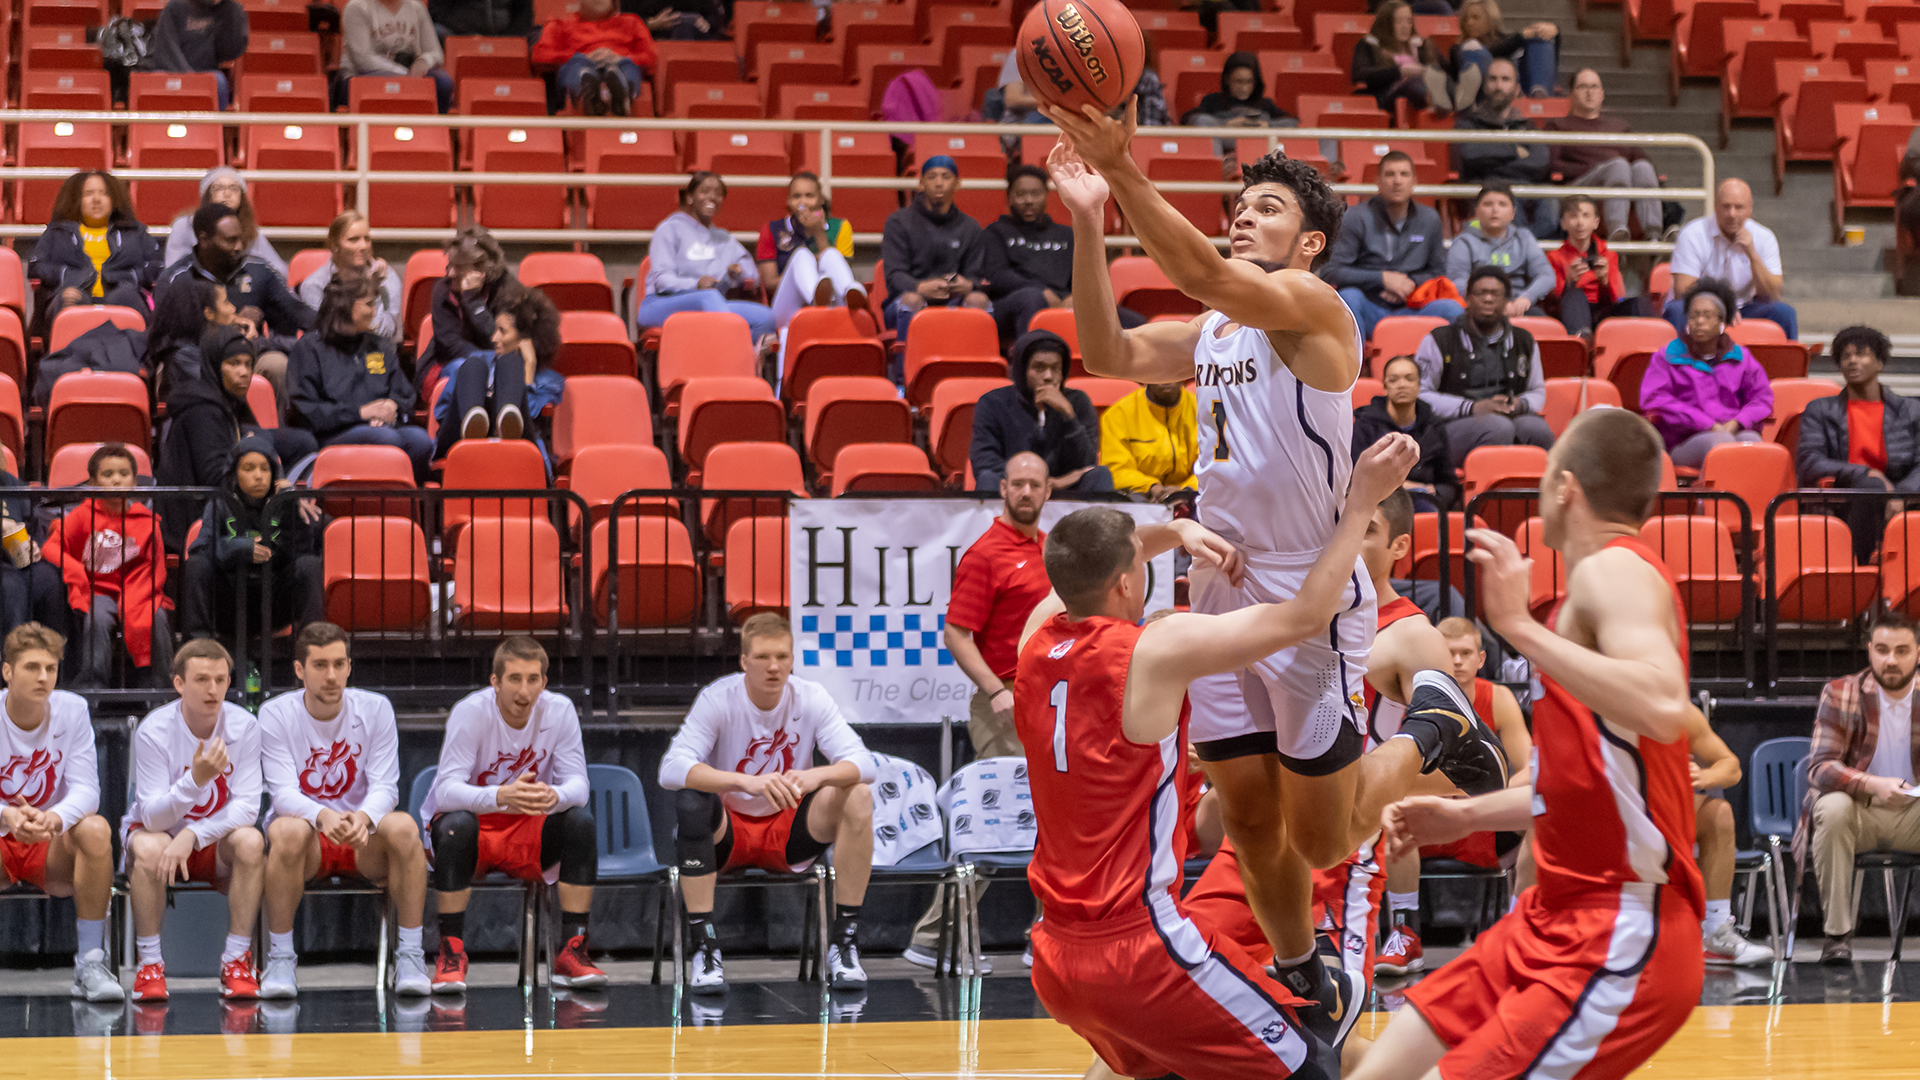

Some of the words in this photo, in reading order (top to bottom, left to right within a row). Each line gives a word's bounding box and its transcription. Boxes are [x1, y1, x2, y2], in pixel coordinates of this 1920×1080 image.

[1031, 36, 1074, 94] NCAA
[1056, 3, 1108, 86] Wilson
[1211, 399, 1230, 462] 1
[852, 678, 899, 702] The
[1049, 679, 1068, 773] 1
